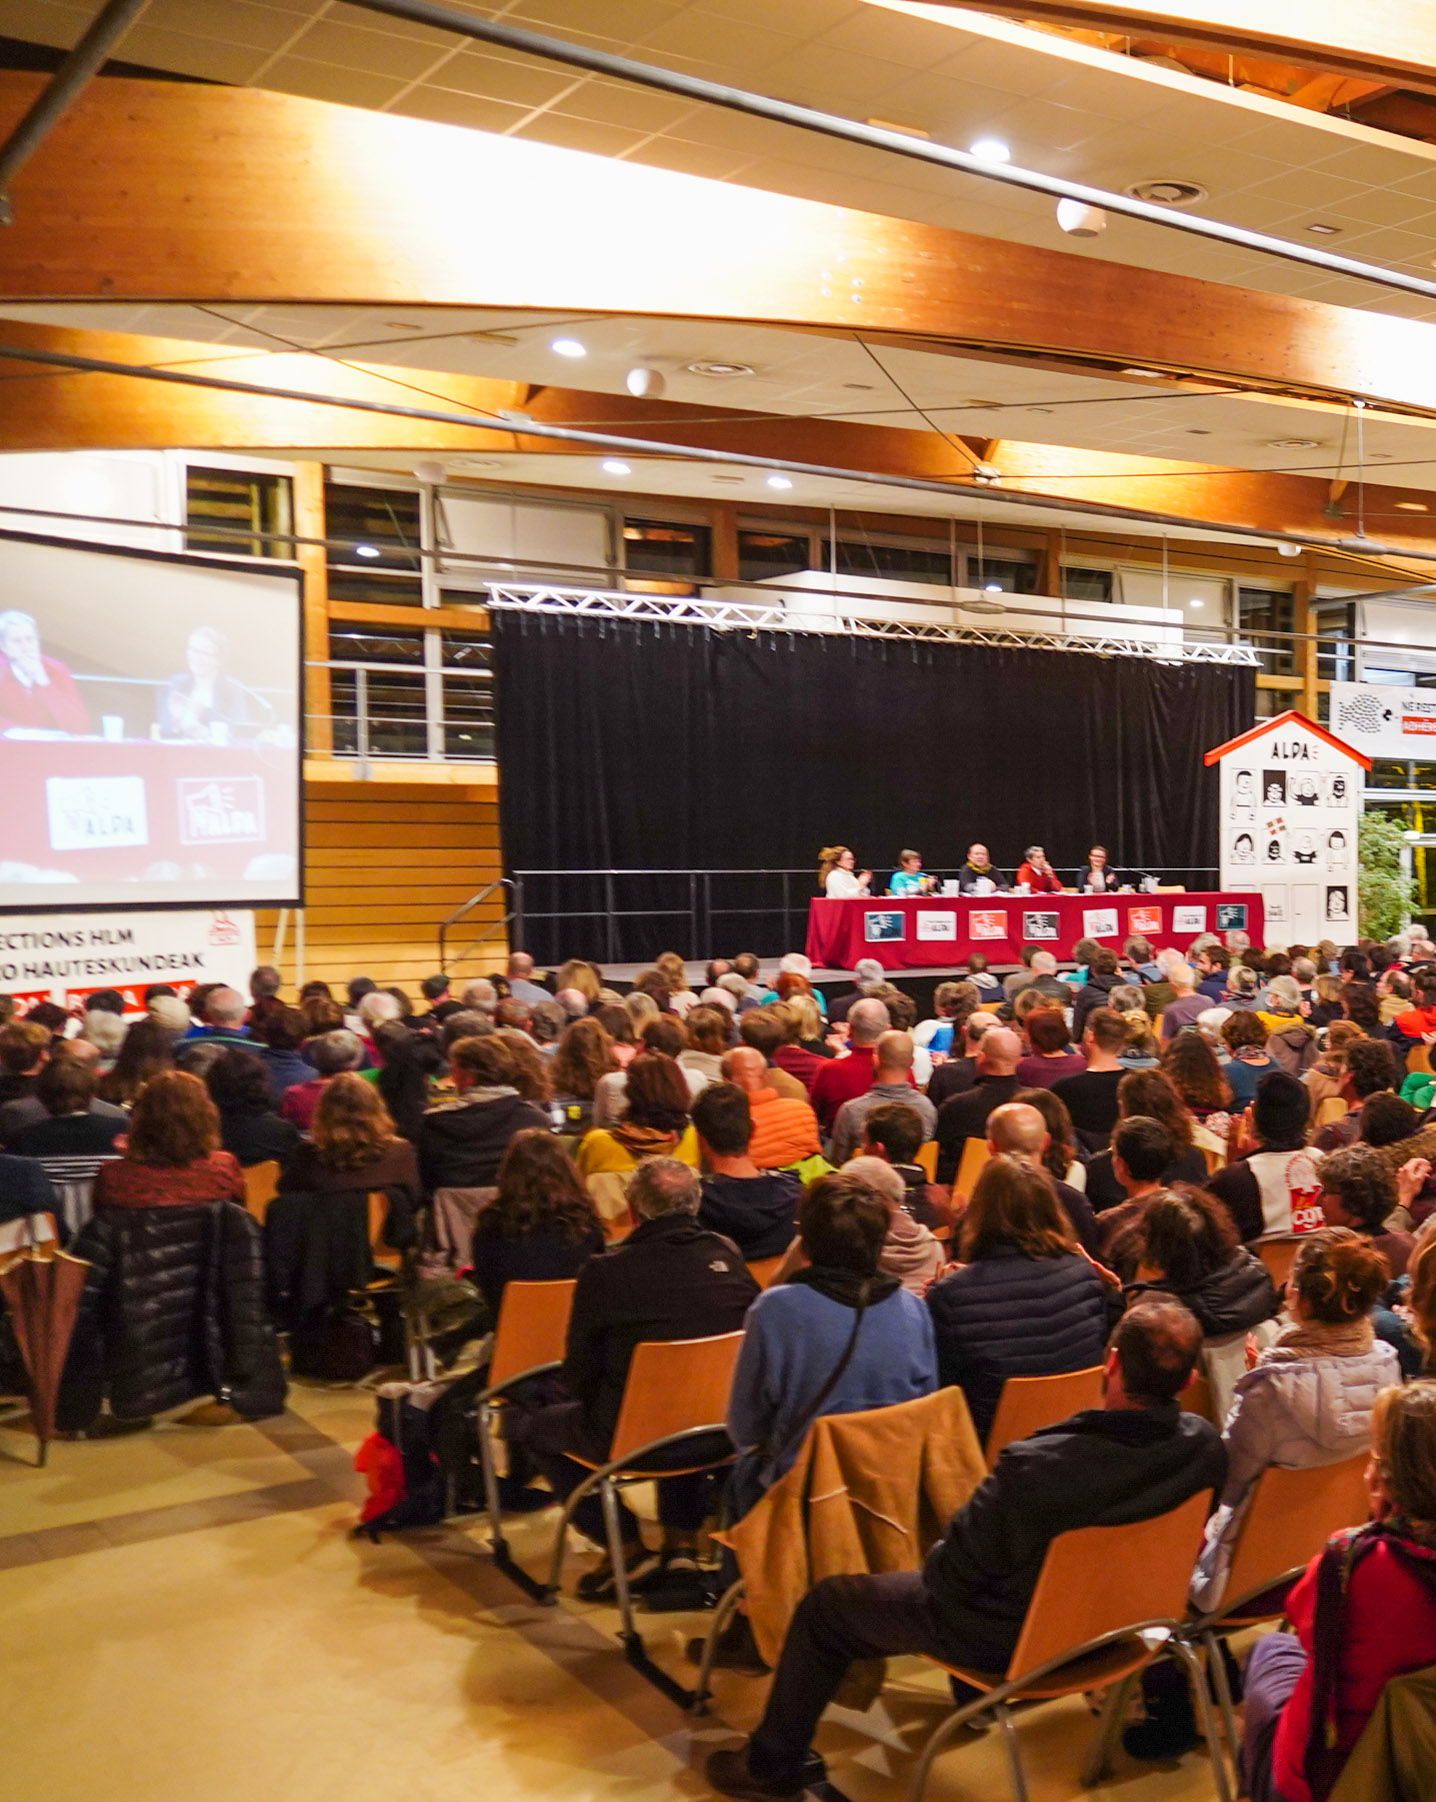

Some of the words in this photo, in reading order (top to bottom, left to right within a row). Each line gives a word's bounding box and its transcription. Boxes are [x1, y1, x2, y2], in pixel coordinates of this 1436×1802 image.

[1402, 701, 1414, 712] NE
[90, 928, 135, 947] HLM
[23, 952, 206, 979] HAUTESKUNDEAK
